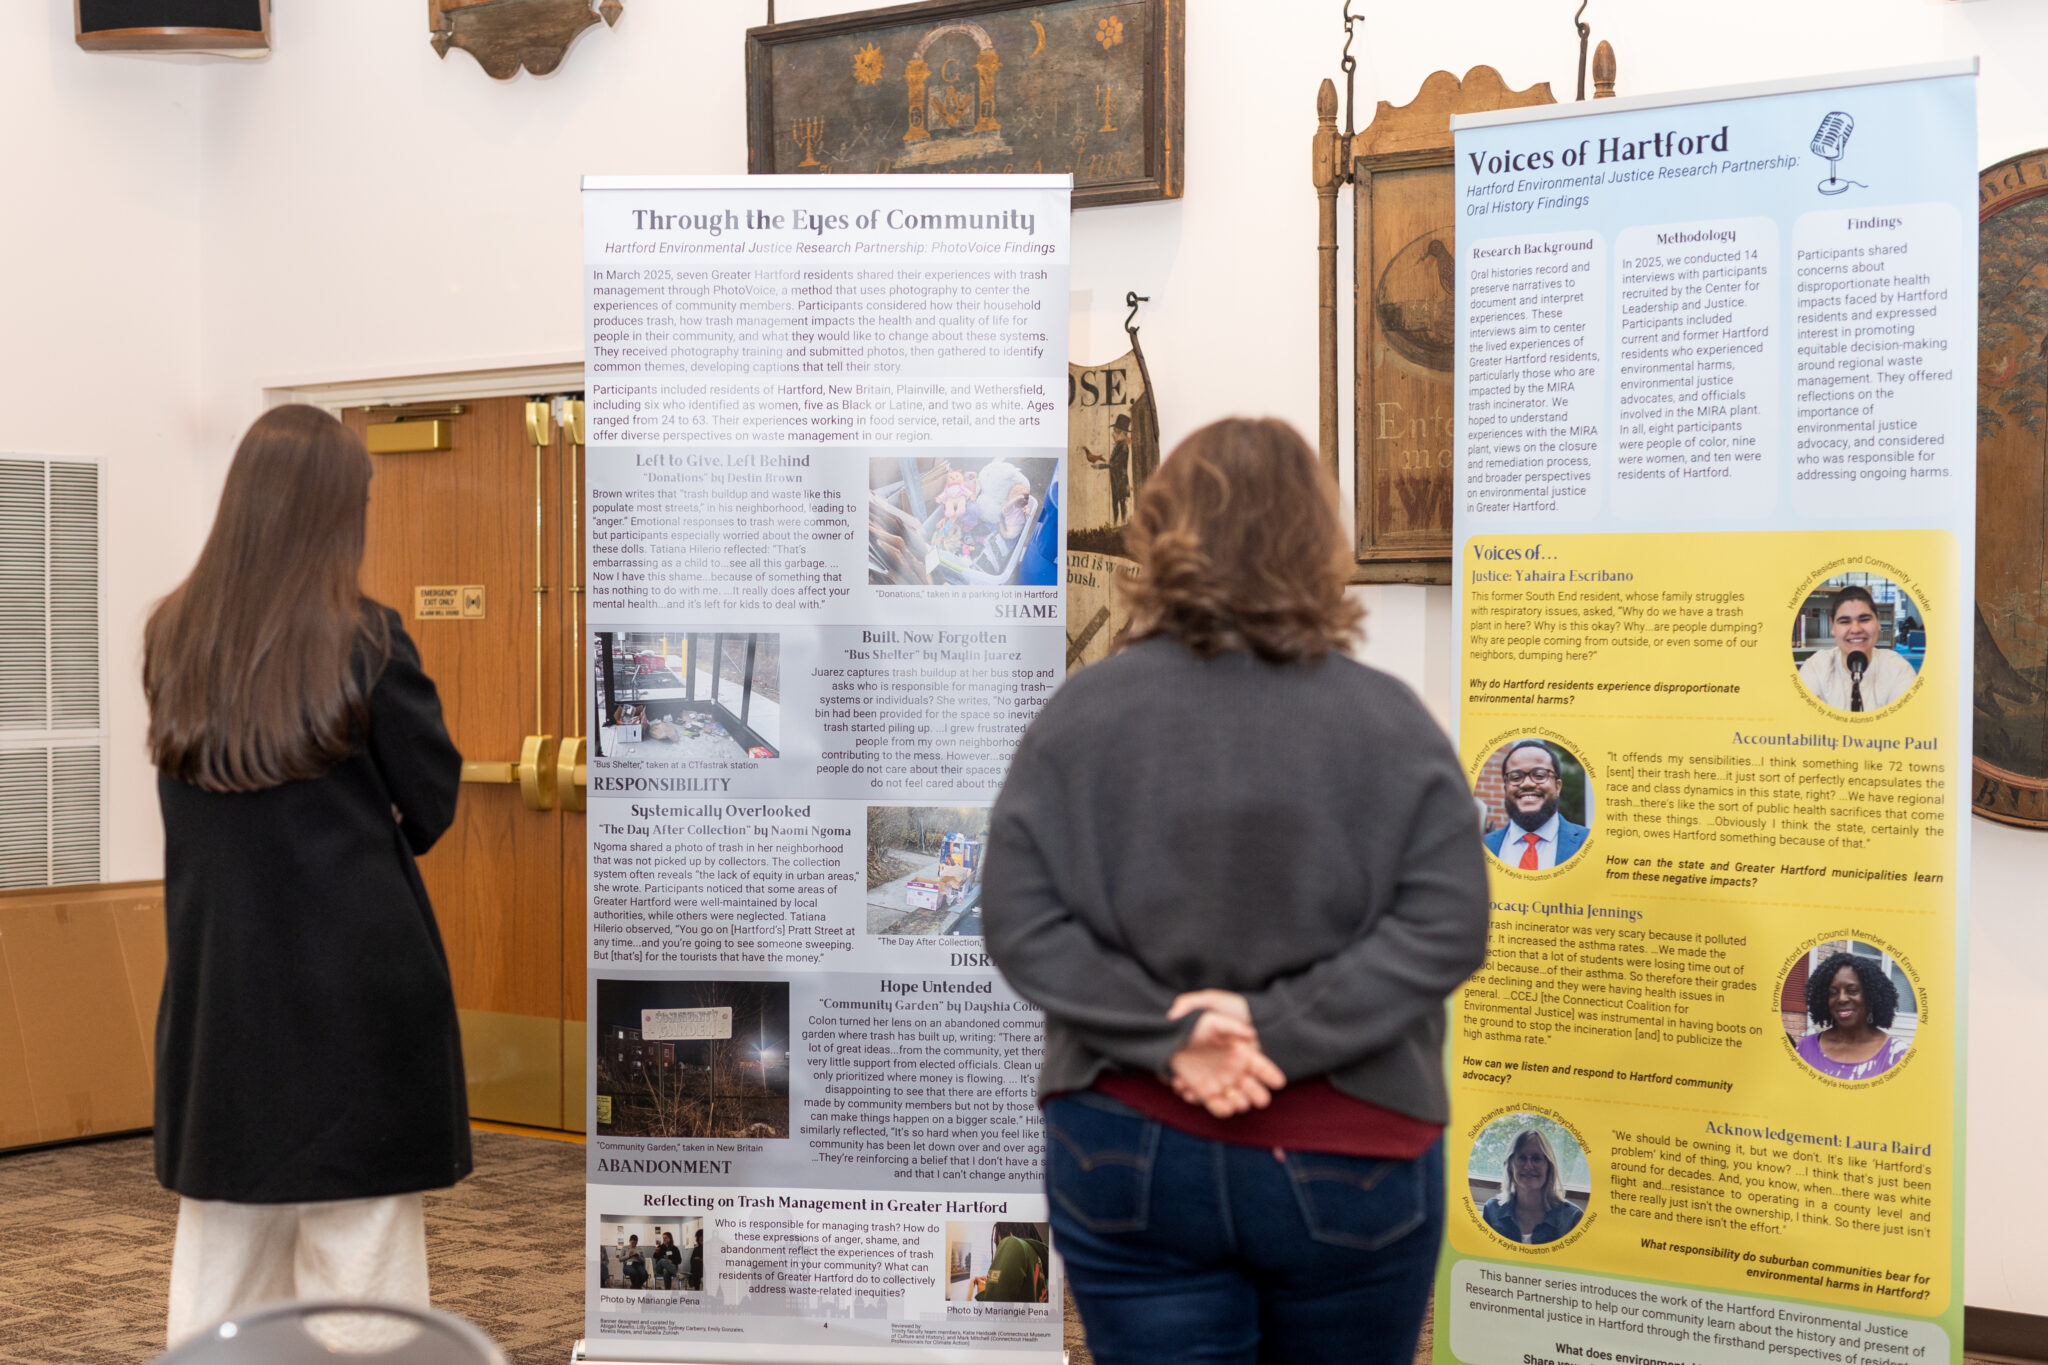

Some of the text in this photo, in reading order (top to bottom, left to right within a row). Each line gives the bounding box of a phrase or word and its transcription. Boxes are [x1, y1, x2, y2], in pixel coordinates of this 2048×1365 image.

[942, 58, 961, 82] G
[1468, 126, 1728, 175] Voices of Hartford
[1466, 155, 1800, 197] Hartford Environmental Justice Research Partnership:
[1466, 195, 1589, 216] Oral History Findings
[632, 209, 1034, 235] Through the Eyes of Community
[1848, 217, 1902, 230] Findings
[1657, 229, 1735, 244] Methodology
[605, 241, 1055, 255] Hartford Environmental Justice Research Partnership: PhotoVoice Findings
[1473, 238, 1592, 258] Research Background
[1622, 249, 1757, 268] In 2025, we conducted 14
[636, 454, 809, 467] Left to Give, Left Behind
[643, 472, 802, 485] "Donations" by Destin Brown
[1466, 500, 1558, 512] in Greater Hartford.
[1474, 545, 1521, 560] Voices
[1472, 569, 1633, 584] Justice: Yahaira Escribano
[1787, 556, 1932, 612] Hartford Resident and Community Leader
[927, 590, 949, 598] taken
[969, 590, 999, 600] parking
[1014, 590, 1022, 598] in
[995, 604, 1057, 618] SHAME
[862, 630, 1006, 646] Built, Now Forgotten
[844, 649, 870, 659] "Bus
[873, 649, 919, 659] Shelter"
[923, 649, 937, 662] by
[984, 649, 1022, 662] Juarez
[1733, 732, 1937, 752] Accountability: Dwayne Paul
[593, 760, 610, 768] "Bus
[688, 760, 728, 768] CTfastrak
[594, 777, 730, 791] RESPONSIBILITY
[632, 804, 810, 820] Systemically Overlooked
[599, 824, 850, 838] "The Day After Collection" by Naomi Ngoma
[1488, 901, 1642, 923] ocacy: Cynthia Jennings
[877, 937, 896, 945] "The
[898, 938, 913, 947] Day
[880, 980, 992, 996] Hope Untended
[819, 998, 1044, 1014] "Community Garden" by Dayshia Colo
[1468, 1102, 1592, 1155] Suburbanite and Clinical Psychologist
[1706, 1121, 1930, 1156] Acknowledgement: Laura Baird
[596, 1141, 644, 1152] "Community
[597, 1158, 731, 1173] ABANDONMENT
[644, 1194, 1007, 1213] Reflecting on Trash Management in Greater Hartford
[600, 1295, 624, 1303] Photo
[626, 1296, 635, 1305] by
[680, 1296, 699, 1305] Pena
[947, 1306, 971, 1314] Photo
[973, 1306, 982, 1316] by
[1028, 1306, 1050, 1316] Pena
